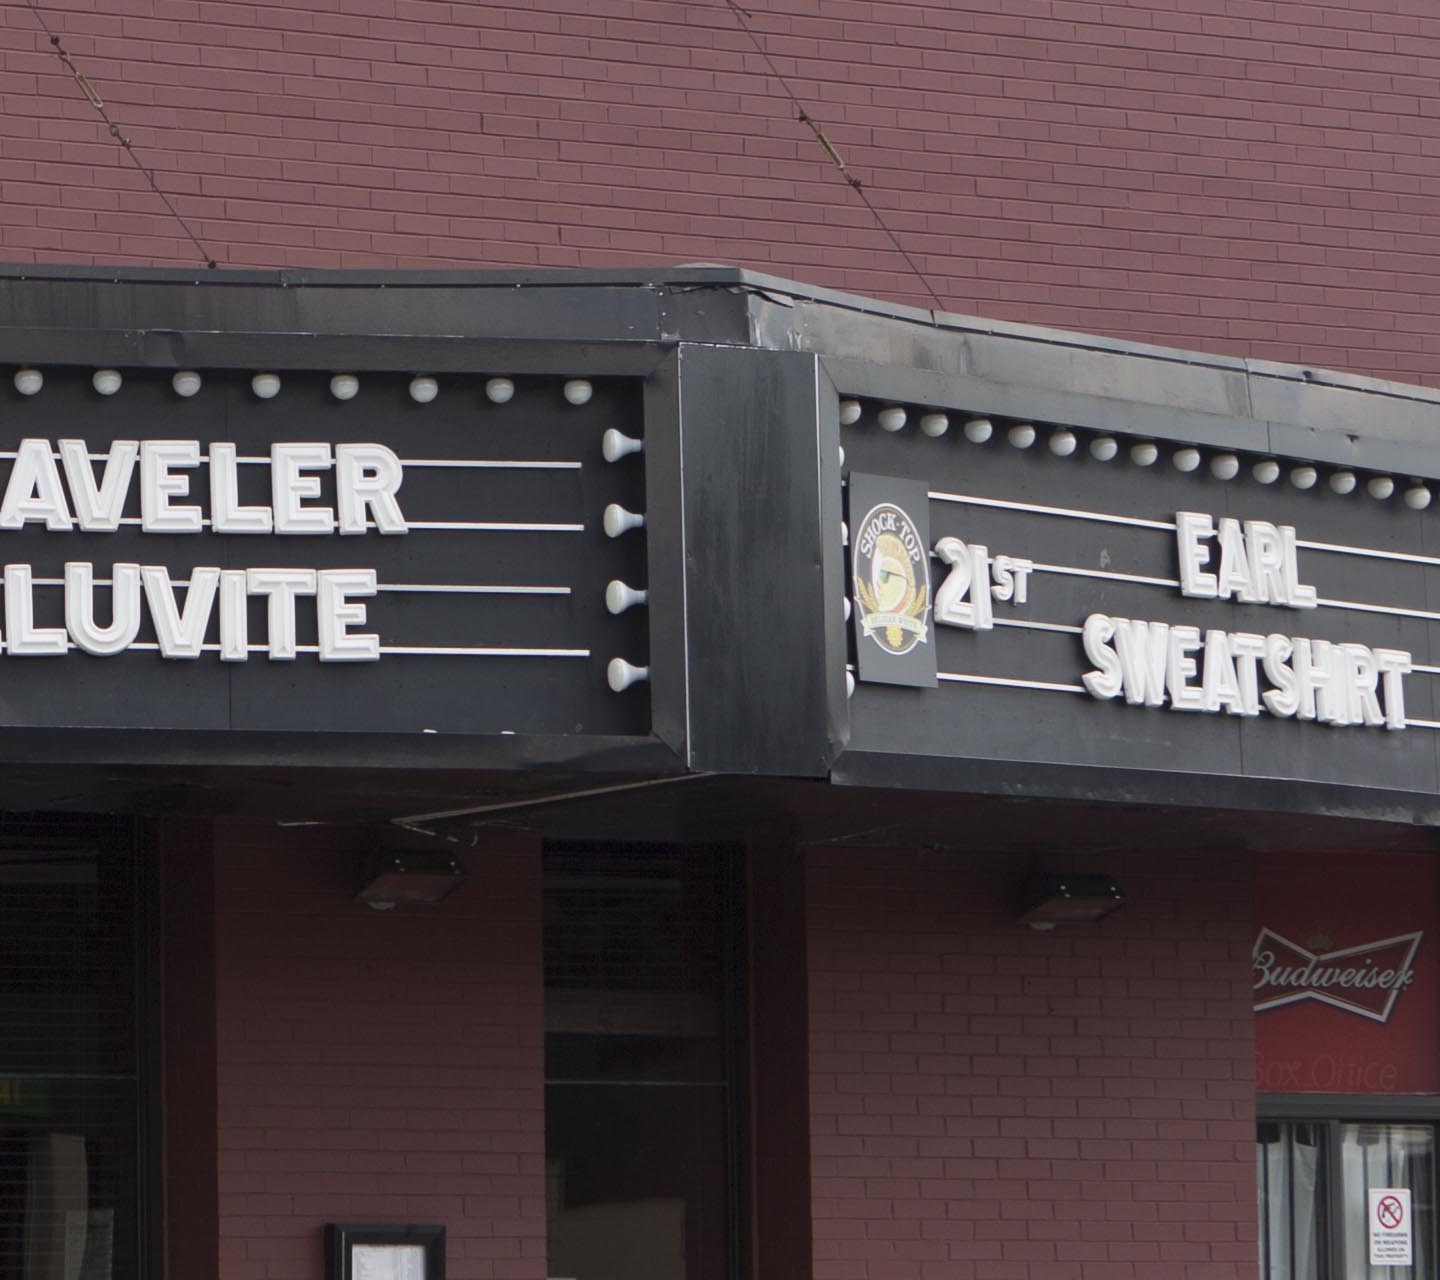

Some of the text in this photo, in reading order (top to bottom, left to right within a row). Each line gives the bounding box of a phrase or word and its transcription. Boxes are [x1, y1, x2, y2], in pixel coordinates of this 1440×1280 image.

[861, 512, 897, 558] SHOCK
[1175, 511, 1318, 610] EARL
[1081, 614, 1413, 730] SWEATSHIRT
[1253, 950, 1415, 991] Budweiser
